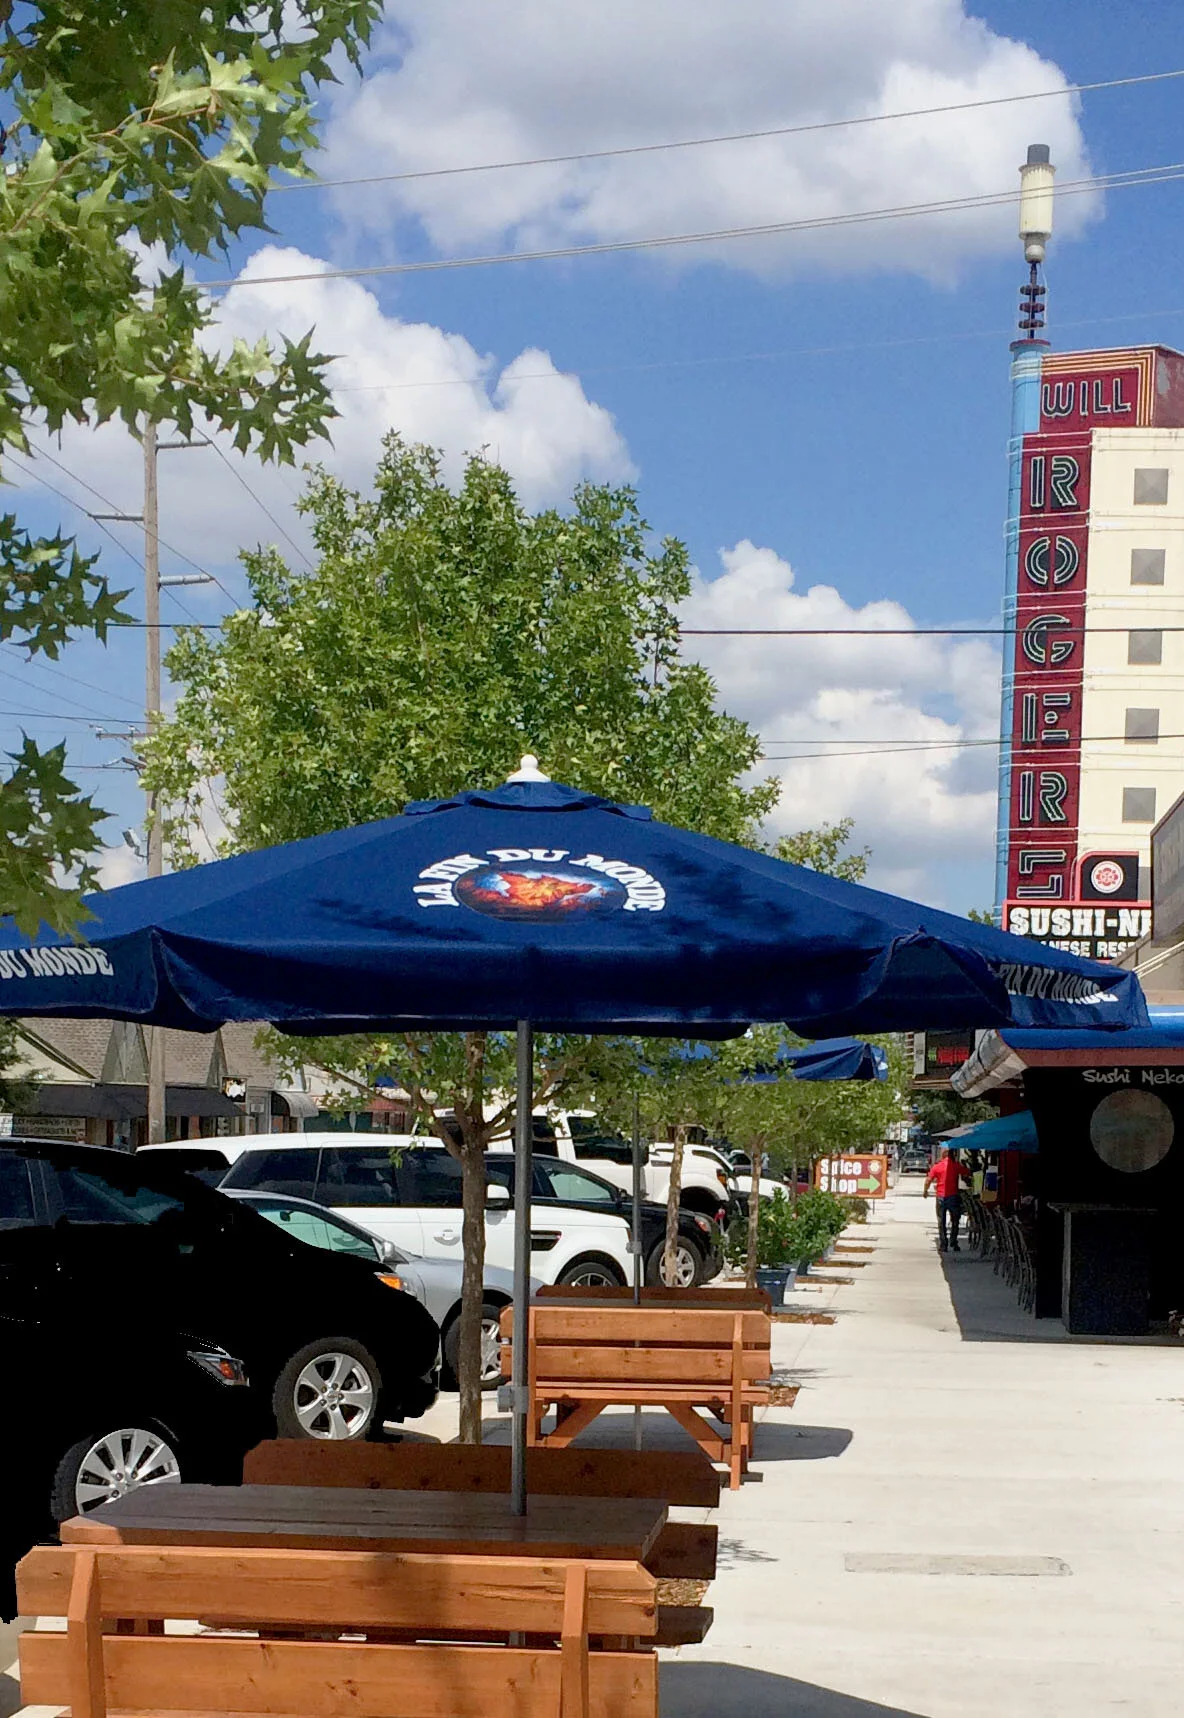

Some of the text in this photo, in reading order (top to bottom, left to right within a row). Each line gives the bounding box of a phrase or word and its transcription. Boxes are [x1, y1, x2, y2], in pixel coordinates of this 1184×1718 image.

[1041, 377, 1132, 417] WILL
[1016, 455, 1080, 899] ROGERS
[412, 848, 667, 912] LA FIN DU MONDE
[19, 946, 114, 977] MONDE
[1081, 1067, 1131, 1084] Sushi
[820, 1175, 858, 1194] Shop
